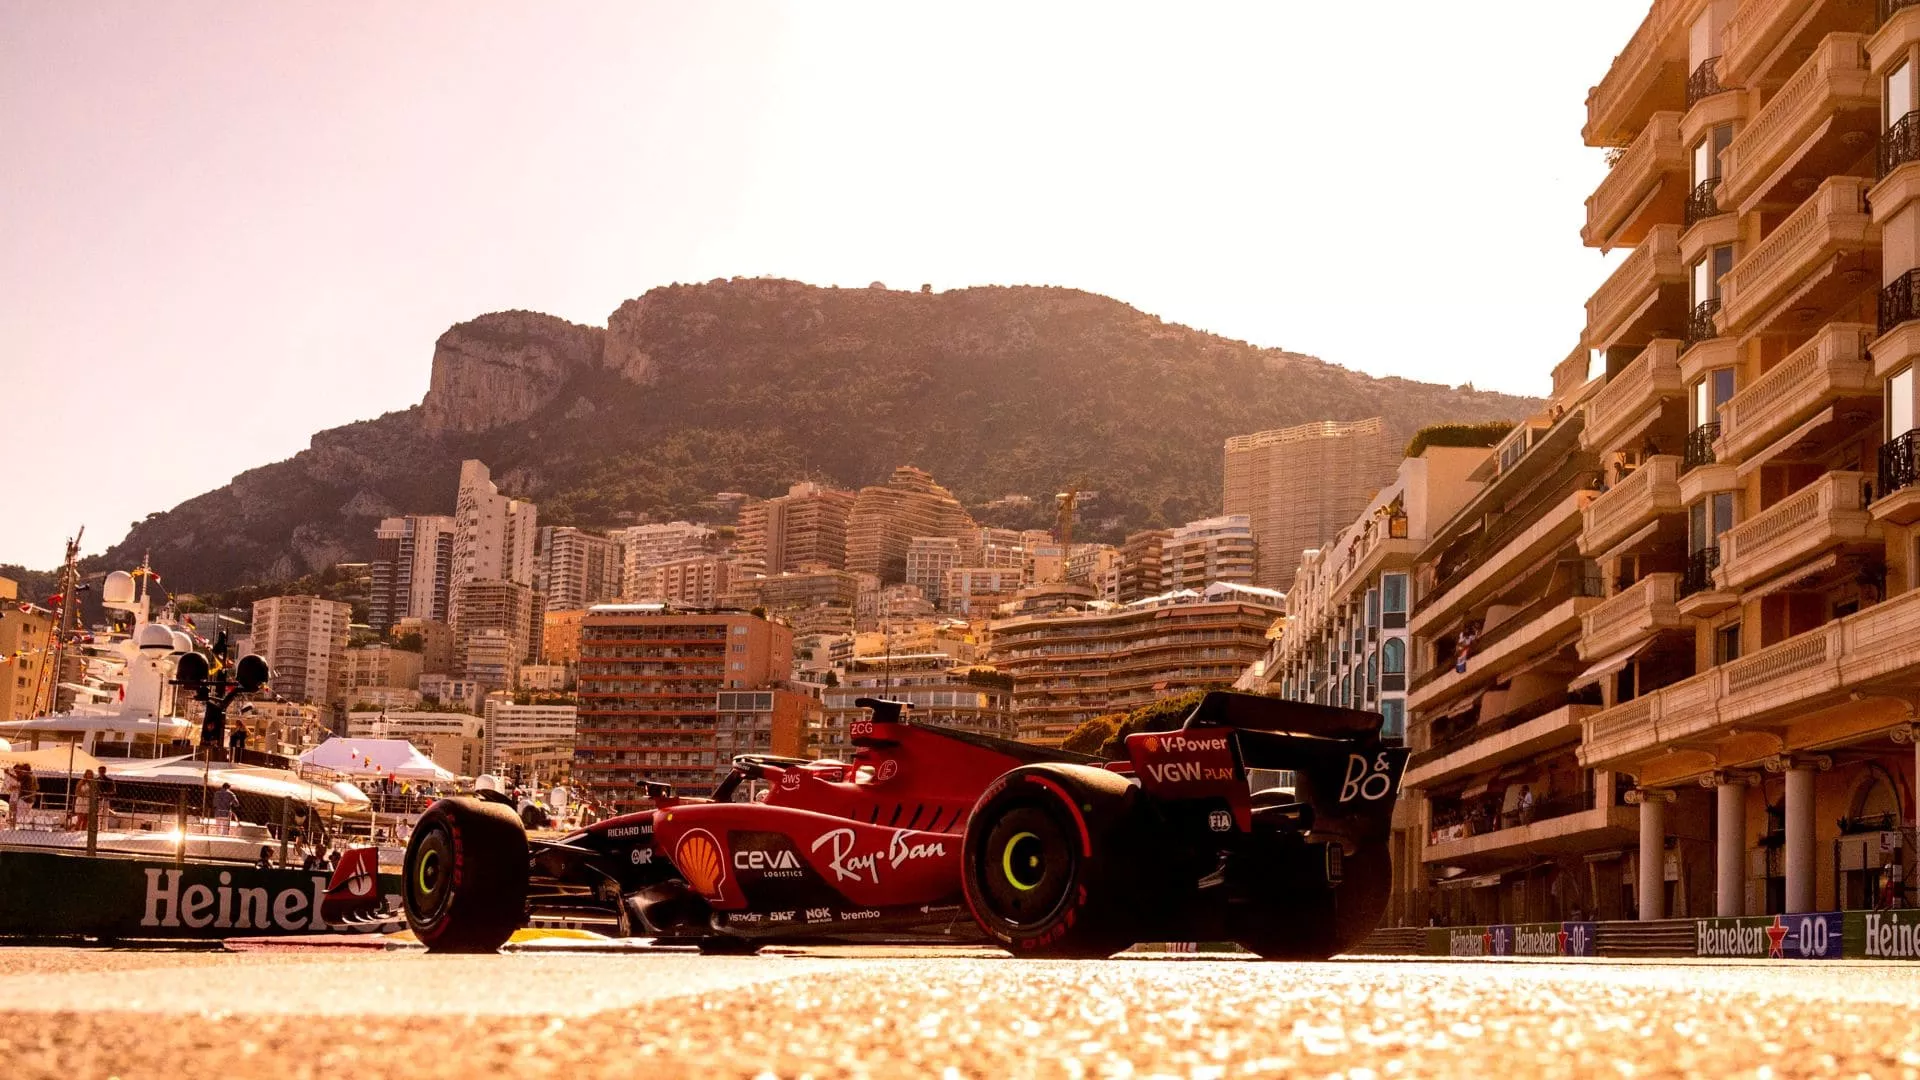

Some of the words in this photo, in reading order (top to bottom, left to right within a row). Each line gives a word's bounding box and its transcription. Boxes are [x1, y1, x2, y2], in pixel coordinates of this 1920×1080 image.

[851, 722, 873, 735] ZCG
[1160, 736, 1228, 752] V-Power
[782, 773, 801, 784] aws
[1146, 761, 1201, 783] VGW
[1203, 767, 1233, 781] PLAY
[607, 826, 639, 838] RICHARD
[763, 870, 803, 878] LOGISTICS
[805, 907, 832, 919] NGK
[841, 910, 881, 921] brembo
[1450, 929, 1482, 956] Heineken
[1514, 926, 1556, 954] Heineken
[1696, 919, 1763, 956] Heineken
[1799, 916, 1828, 957] 0.0
